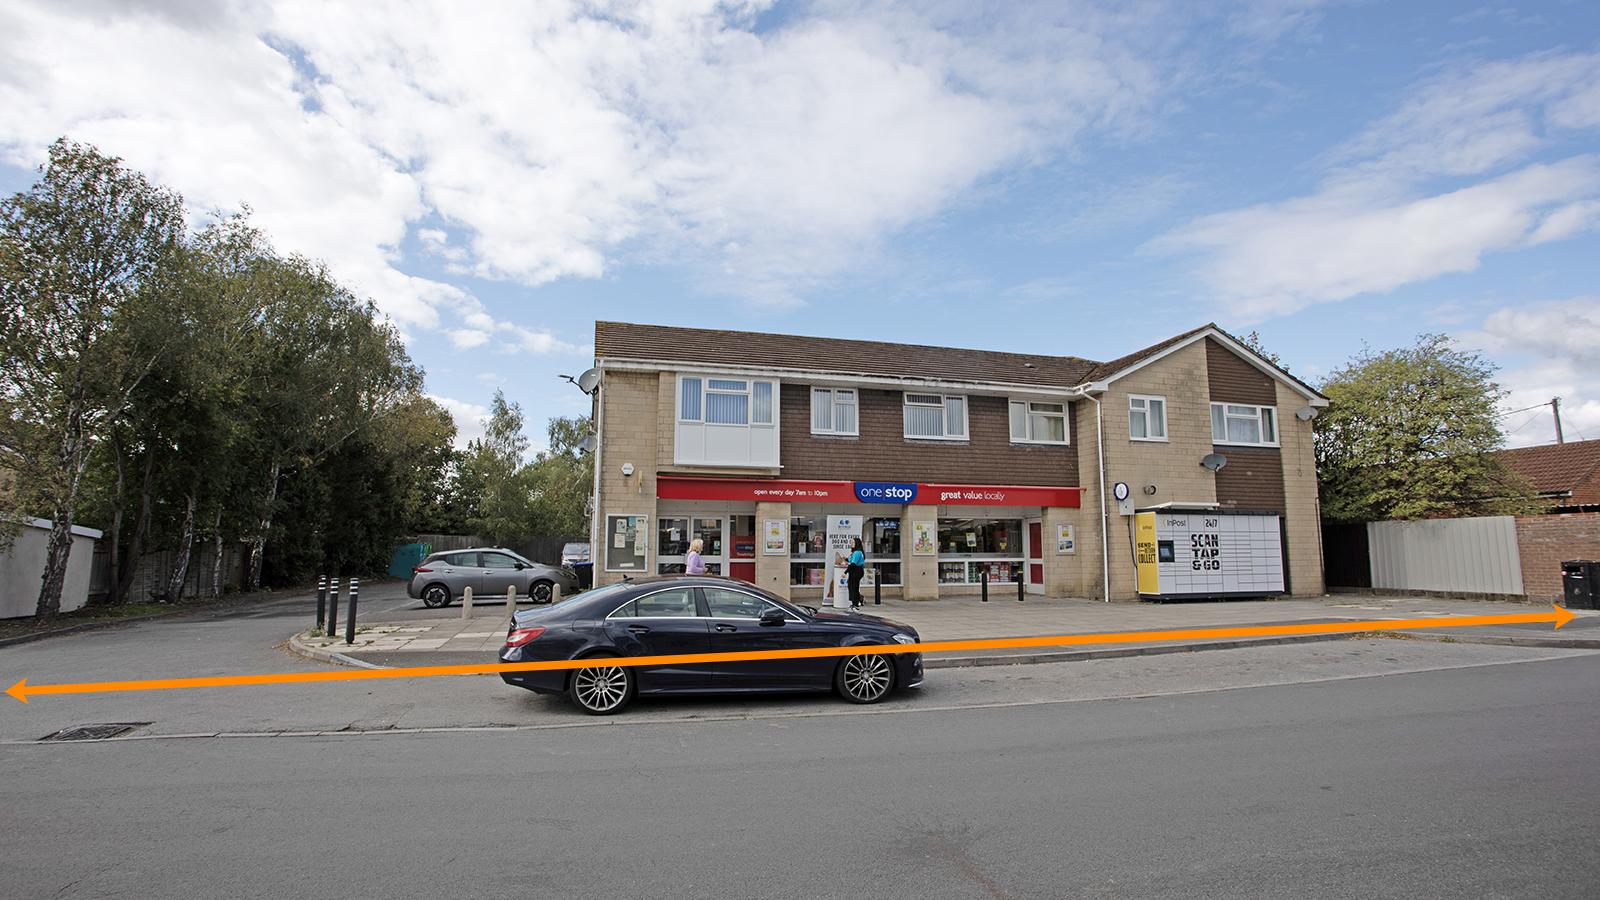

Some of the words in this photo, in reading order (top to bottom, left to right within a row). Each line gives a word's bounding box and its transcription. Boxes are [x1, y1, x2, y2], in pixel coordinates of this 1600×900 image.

[861, 486, 882, 498] one
[885, 486, 913, 501] stop
[941, 491, 961, 501] great
[963, 490, 983, 499] value
[984, 491, 1005, 502] locally
[1205, 518, 1218, 528] 24/7
[1191, 534, 1219, 547] SCAN
[1192, 549, 1219, 560] TAP
